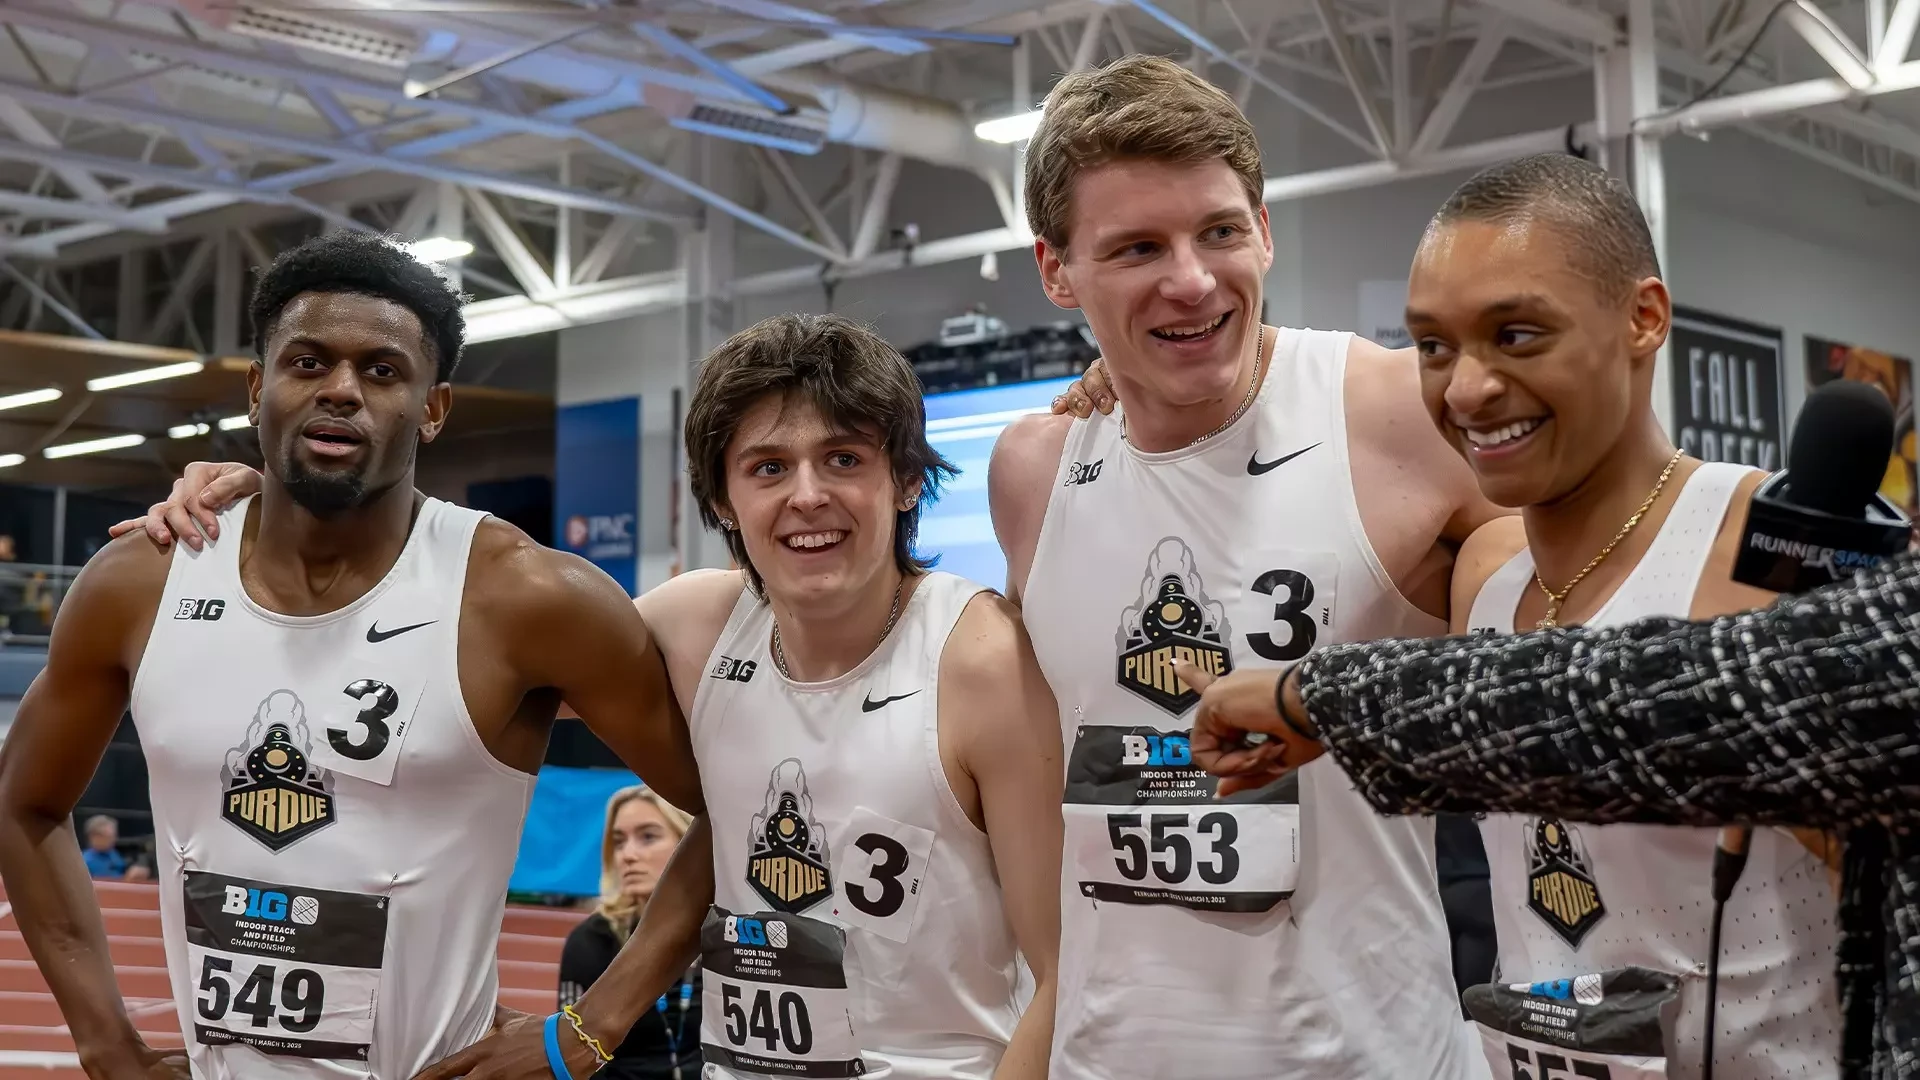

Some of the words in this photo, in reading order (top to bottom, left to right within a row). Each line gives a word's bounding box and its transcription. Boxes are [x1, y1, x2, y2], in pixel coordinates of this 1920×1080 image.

[1688, 347, 1765, 432] FALL
[1246, 569, 1317, 661] 3
[1125, 645, 1225, 696] PURDUE
[327, 678, 399, 761] 3
[1140, 771, 1173, 779] INDOOR
[1175, 770, 1207, 778] TRACK
[1170, 780, 1196, 788] FIELD
[1136, 789, 1208, 798] CHAMPIONSHIPS
[229, 787, 327, 833] PURDUE
[1107, 812, 1240, 885] 553
[752, 856, 826, 902] PURDUE
[844, 832, 910, 918] 3
[1532, 871, 1600, 926] PURDUE
[235, 920, 267, 931] INDOOR
[268, 924, 296, 935] TRACK
[243, 931, 260, 940] AND
[262, 933, 286, 943] FIELD
[230, 938, 296, 954] CHAMPIONSHIPS
[733, 947, 757, 956] INDOOR
[757, 950, 777, 959] TRACK
[735, 965, 782, 977] CHAMPIONSHIPS
[754, 959, 772, 967] FIELD
[197, 954, 325, 1033] 549
[1522, 999, 1550, 1012] INDOOR
[1551, 1004, 1578, 1017] TRACK
[721, 982, 813, 1055] 540
[1530, 1012, 1544, 1023] AND
[1545, 1016, 1568, 1027] FIELD
